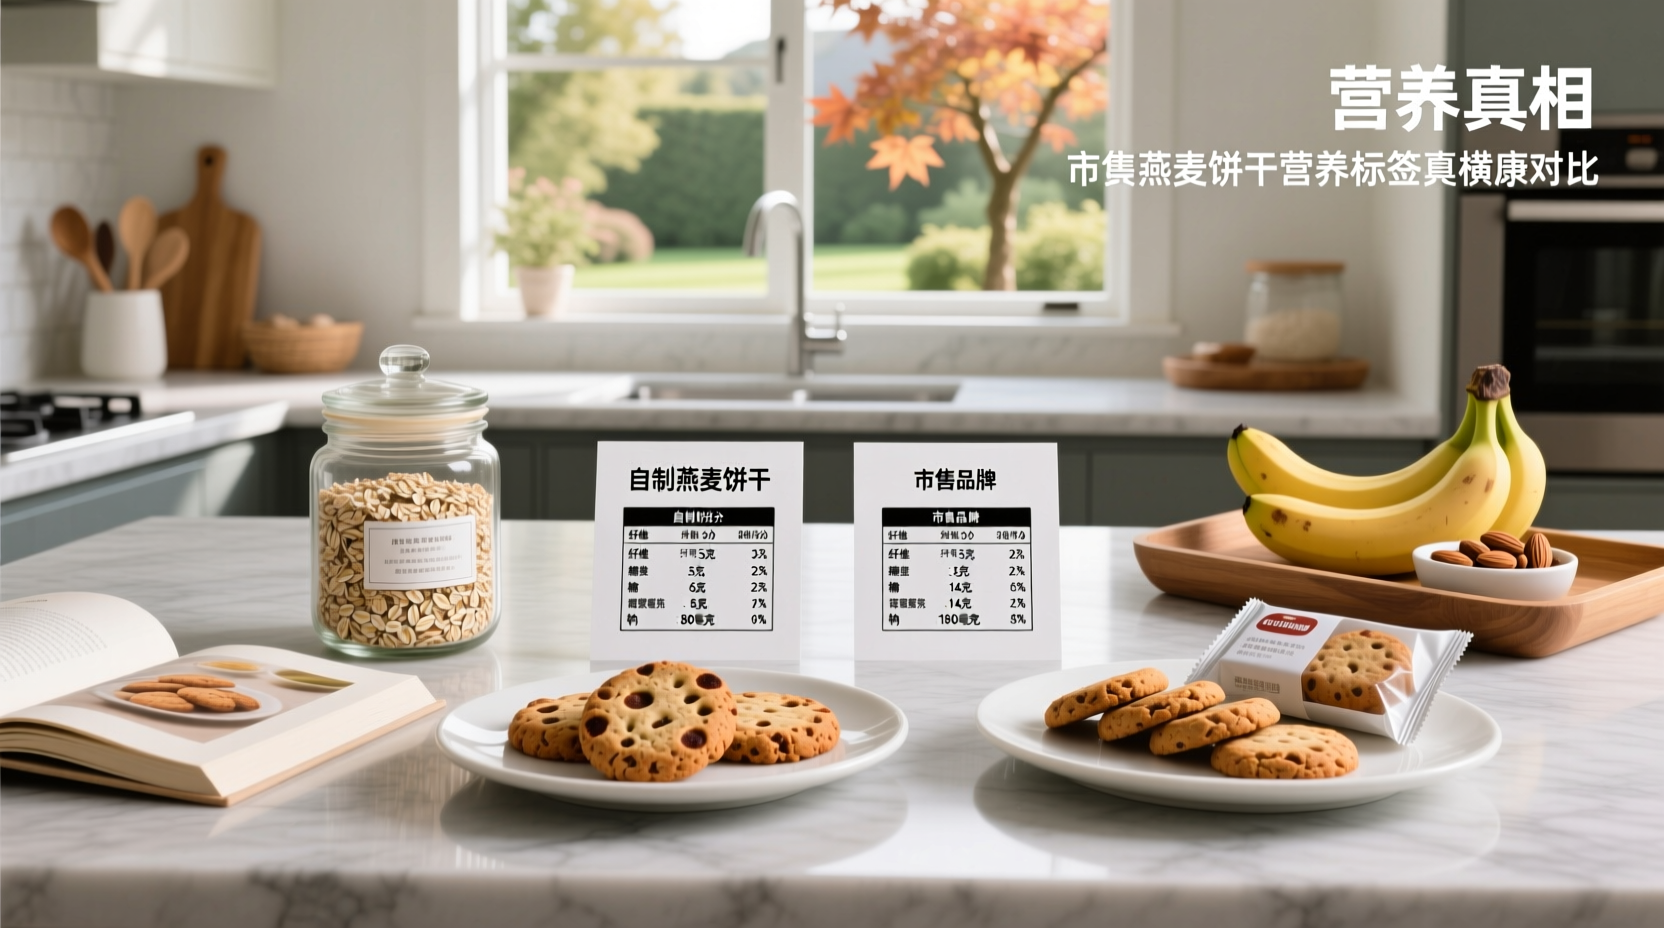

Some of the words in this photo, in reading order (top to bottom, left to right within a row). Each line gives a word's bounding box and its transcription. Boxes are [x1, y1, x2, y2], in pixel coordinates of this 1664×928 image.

[631, 466, 770, 492] 自制燕麦饼干
[914, 468, 996, 491] 市售品牌
